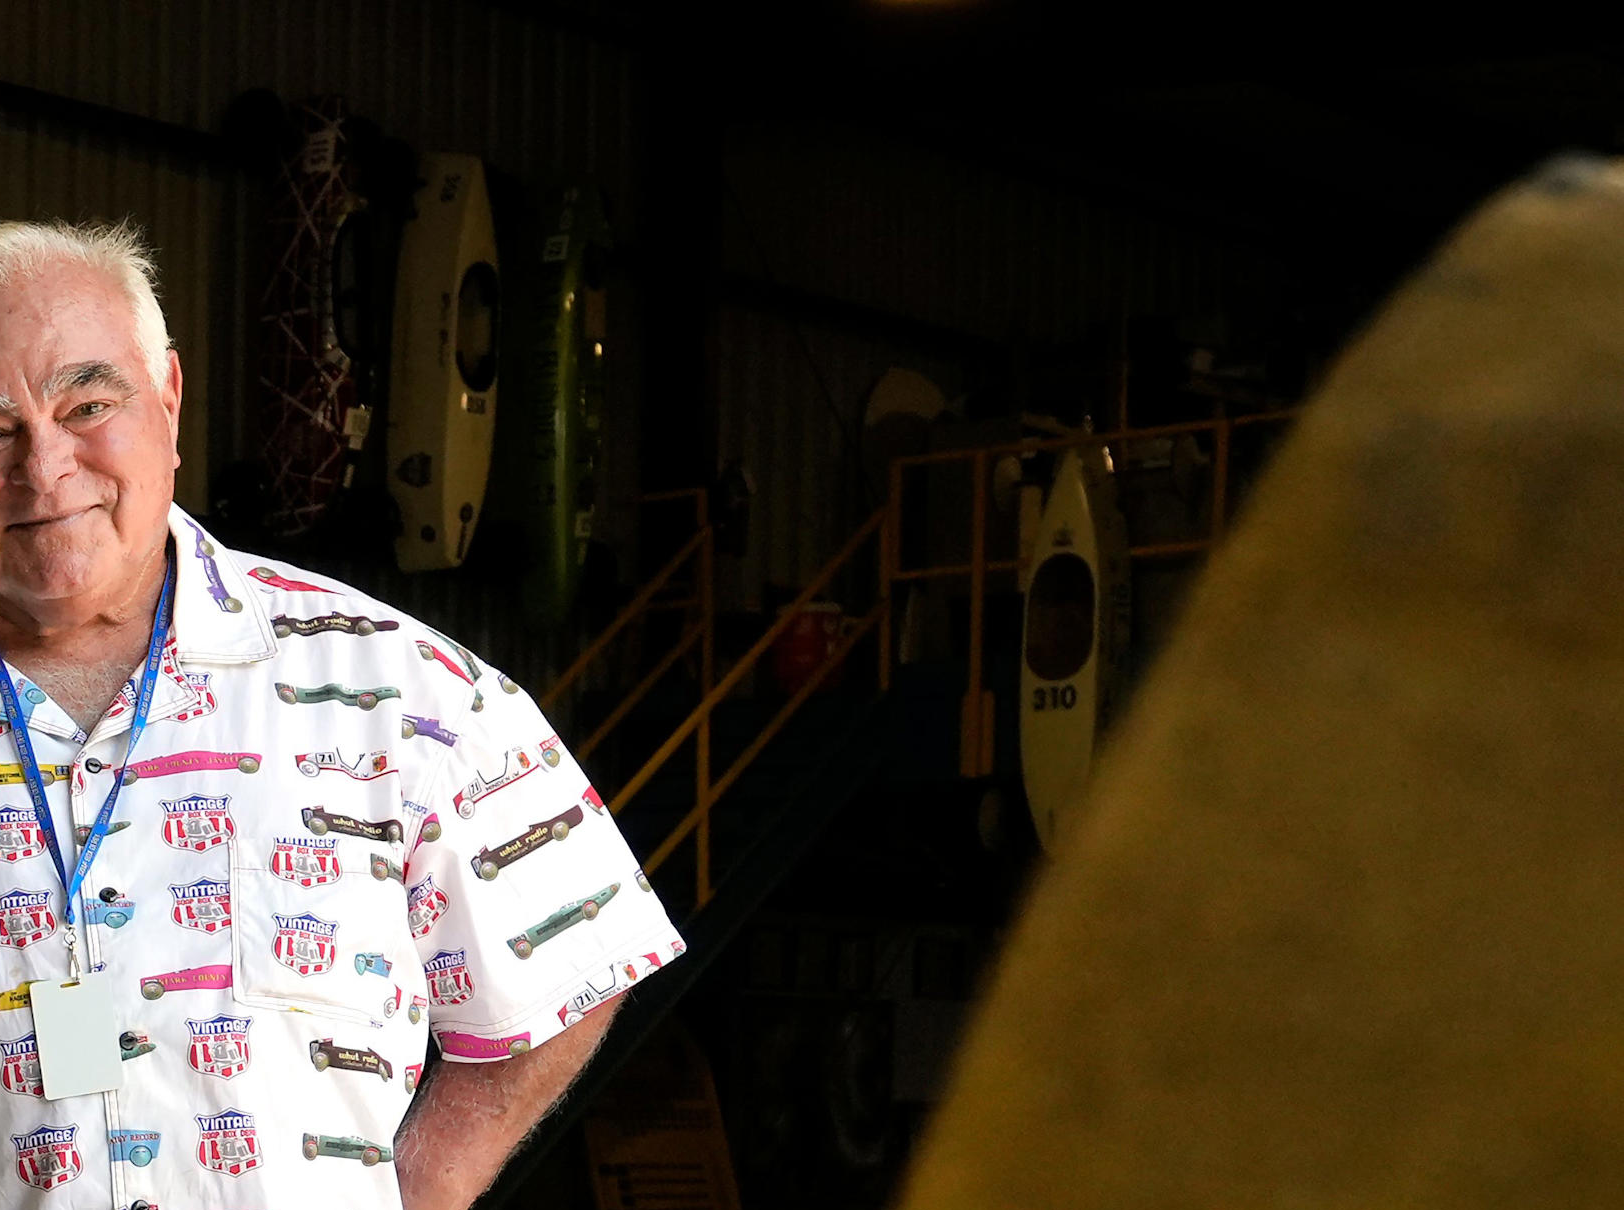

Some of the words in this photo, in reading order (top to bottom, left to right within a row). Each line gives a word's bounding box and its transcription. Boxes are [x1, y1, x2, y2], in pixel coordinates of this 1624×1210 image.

[1033, 685, 1076, 711] 310
[208, 755, 242, 764] JAYCEE
[319, 754, 333, 764] 71
[470, 783, 480, 794] 71
[164, 798, 225, 812] VINTAGE
[525, 827, 548, 843] radio
[76, 860, 89, 876] SOAP
[83, 850, 93, 861] BOX
[88, 833, 102, 850] DERBY
[278, 918, 334, 936] VINTAGE
[576, 993, 592, 1006] 71
[192, 1020, 247, 1035] VINTAGE
[3, 1040, 35, 1056] VINT
[17, 1130, 72, 1150] VINTAGE
